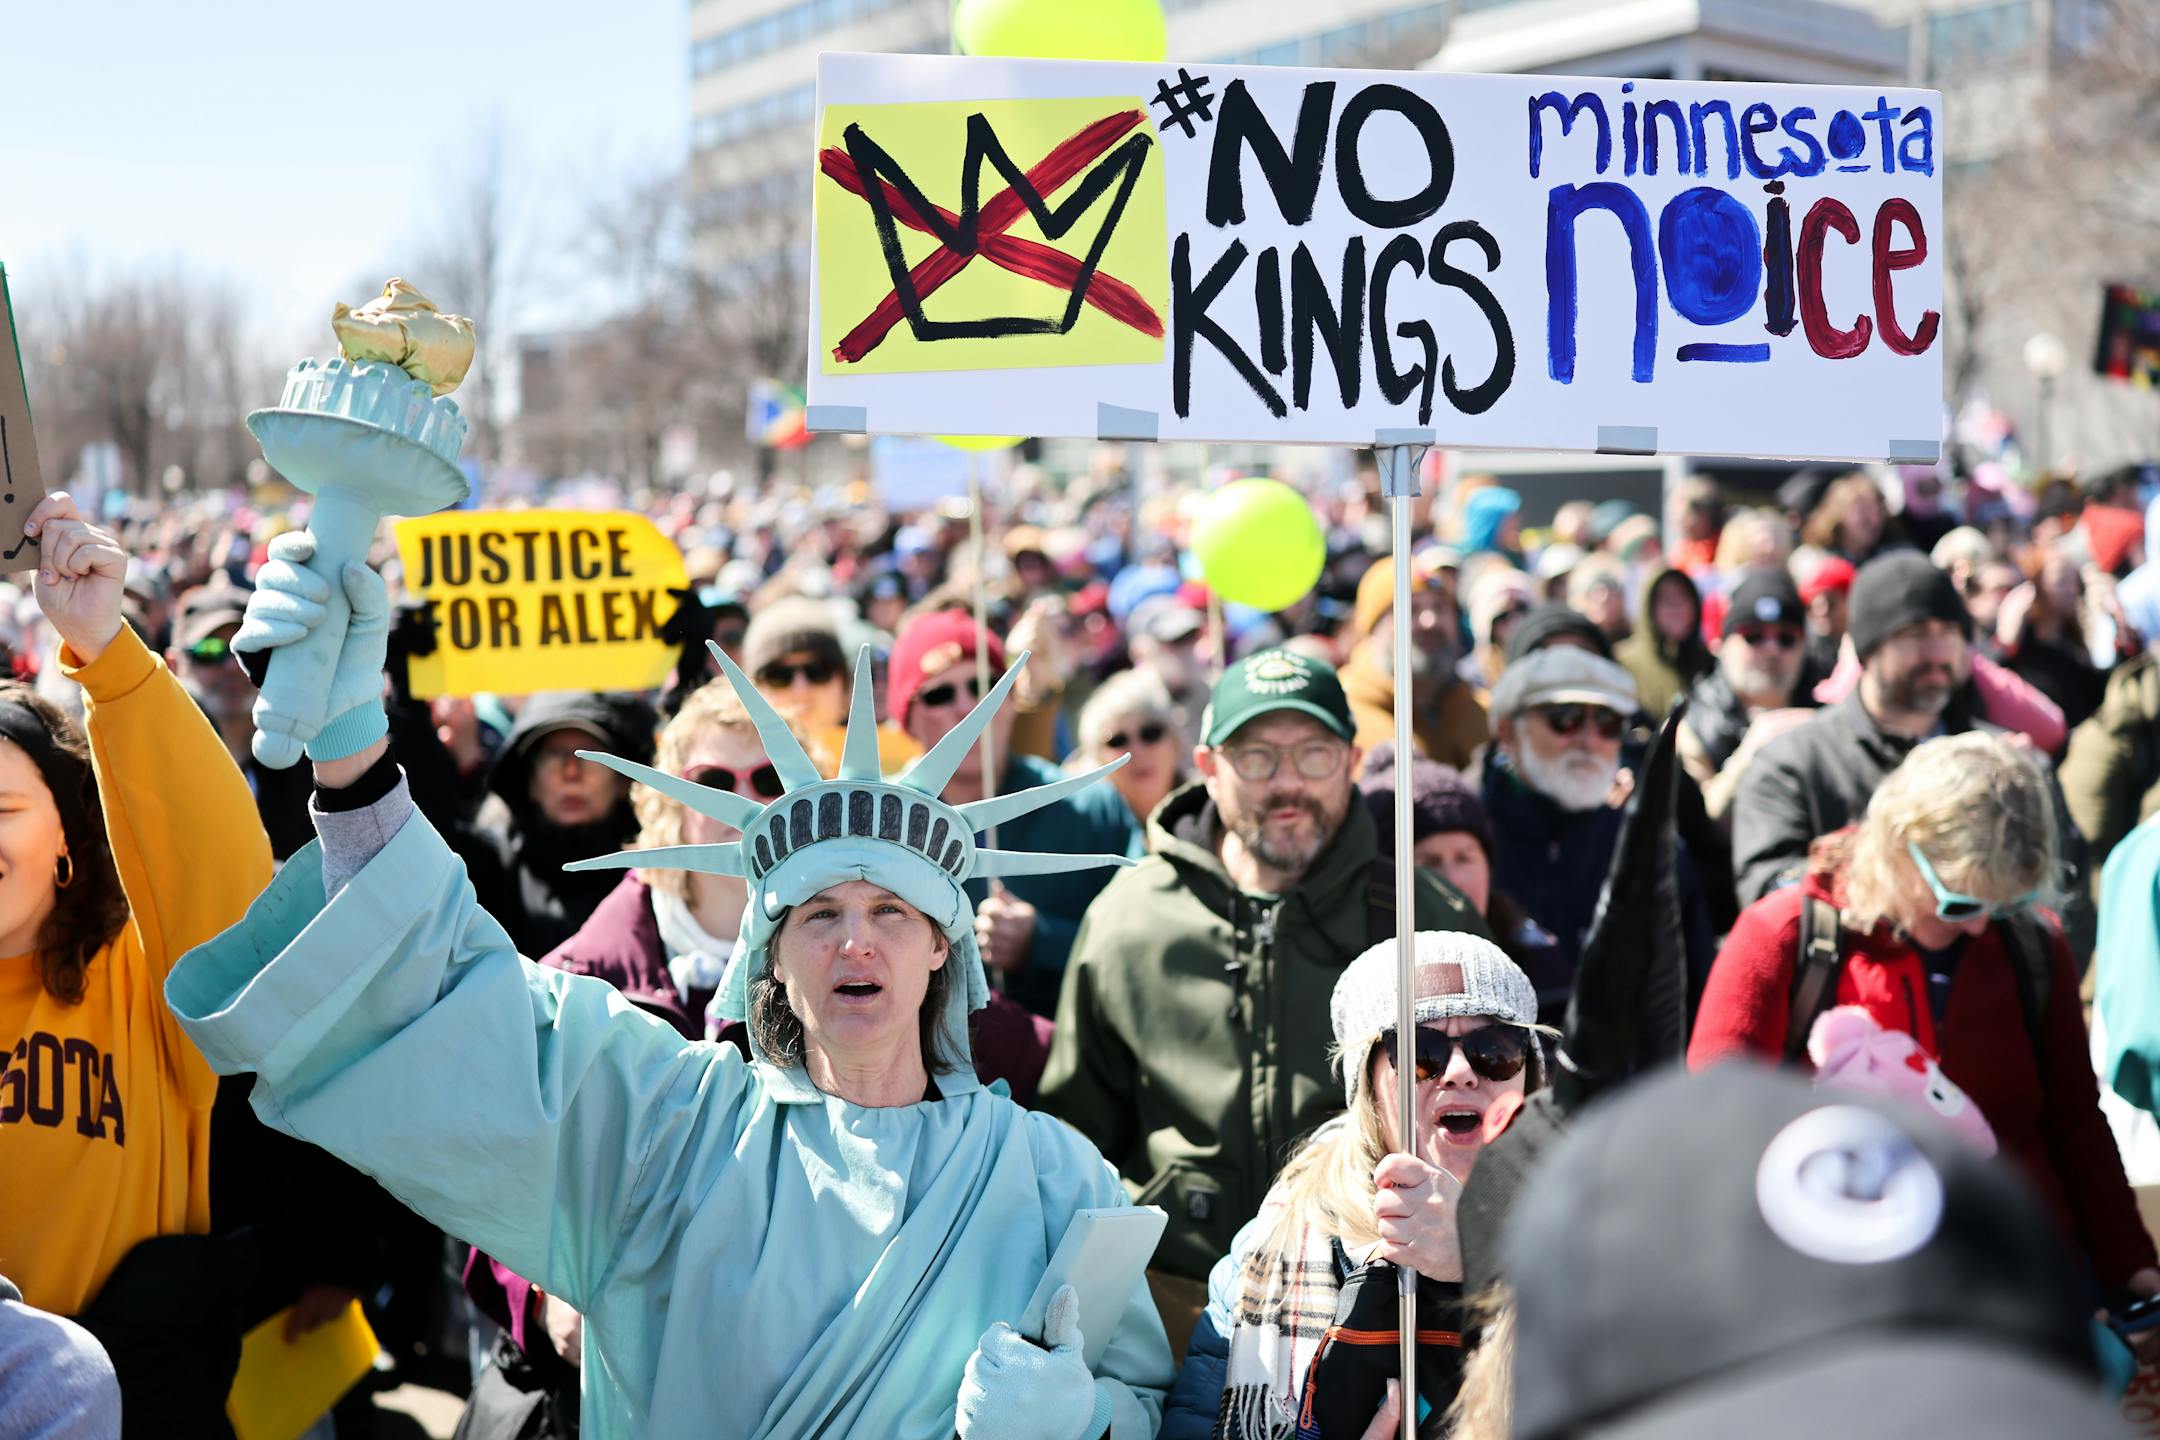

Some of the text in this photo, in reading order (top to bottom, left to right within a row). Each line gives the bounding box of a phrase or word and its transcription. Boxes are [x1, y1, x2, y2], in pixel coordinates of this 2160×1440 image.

[1151, 67, 1455, 228] #NO
[1171, 219, 1517, 427] KINGS
[420, 528, 634, 588] JUSTICE
[539, 588, 661, 647] ALEX
